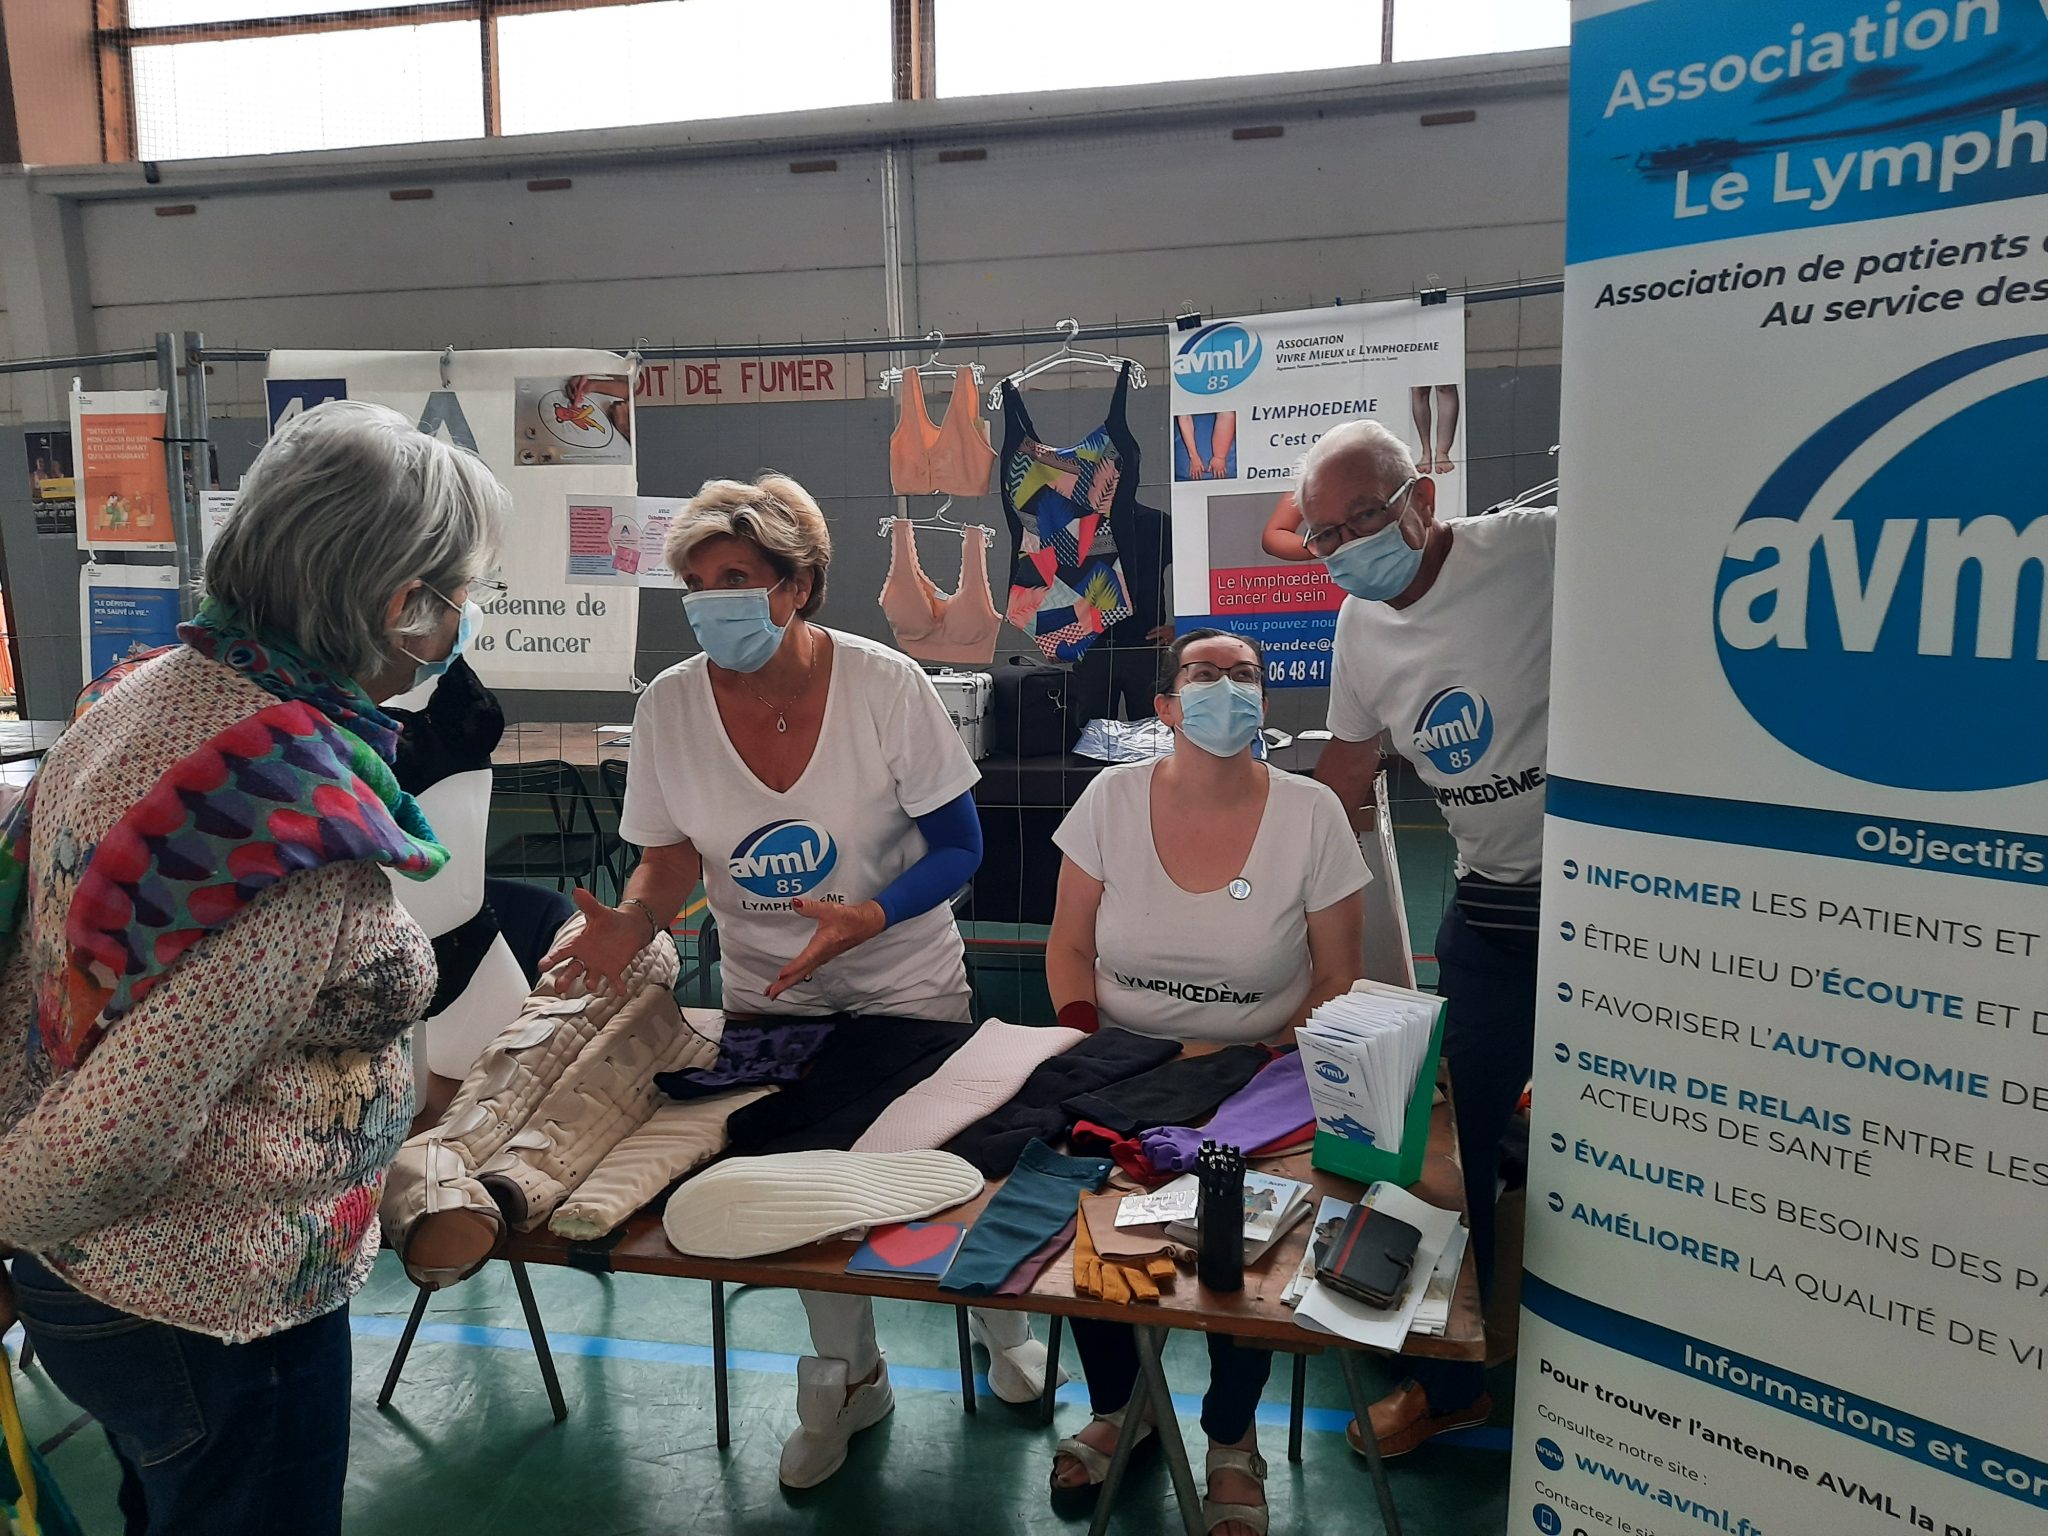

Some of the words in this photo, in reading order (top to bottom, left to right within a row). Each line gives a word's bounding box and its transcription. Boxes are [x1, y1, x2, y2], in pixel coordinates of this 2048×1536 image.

[1603, 0, 2000, 119] Association
[1673, 169, 1749, 219] Le
[1594, 261, 1785, 308] Association
[1797, 253, 1845, 283] de
[1854, 232, 2030, 284] patients
[1760, 301, 1812, 328] Au
[1823, 286, 1964, 323] service
[1976, 275, 2048, 307] des
[684, 364, 722, 395] DE
[741, 360, 835, 393] FUMER
[1174, 339, 1244, 375] avml
[1207, 375, 1229, 391] 85
[1252, 399, 1378, 421] LYMPHOEDEME
[1270, 432, 1306, 447] C'est
[576, 592, 606, 616] de
[1218, 575, 1236, 589] Le
[1218, 593, 1267, 605] cancer
[1272, 590, 1290, 603] du
[1296, 588, 1326, 602] sein
[505, 628, 591, 653] Cancer
[1230, 620, 1259, 631] Vous
[1262, 619, 1307, 633] pouvez
[1269, 661, 1285, 681] 06
[1289, 660, 1305, 680] 48
[1310, 660, 1325, 680] 41
[1412, 705, 1480, 753] avml
[1450, 749, 1472, 769] 85
[728, 840, 817, 878] avml
[1855, 825, 2046, 874] Objectifs
[777, 878, 802, 893] 85
[1586, 864, 1742, 909] INFORMER
[1751, 890, 1808, 919] LES
[1818, 900, 1983, 949] PATIENTS
[1995, 929, 2040, 957] ET
[1583, 923, 1650, 960] ÊTRE
[1659, 942, 1701, 970] UN
[1712, 951, 1779, 983] LIEU
[1791, 966, 1964, 1020] D'ÉCOUTE
[1976, 1000, 2021, 1029] ET
[1581, 989, 1740, 1043] FAVORISER
[1750, 1027, 1990, 1099] L'AUTONOMIE
[2002, 1079, 2048, 1112] DE
[1577, 1050, 1678, 1094] SERVIR
[1686, 1079, 1728, 1106] DE
[1738, 1090, 1852, 1137] RELAIS
[1862, 1121, 1974, 1168] ENTRE
[1987, 1150, 2048, 1187] LES
[1580, 1082, 1709, 1134] ACTEURS
[1718, 1117, 1759, 1147] DE
[1768, 1131, 1873, 1177] SANTÉ
[1574, 1141, 1705, 1197] ÉVALUER
[1713, 1181, 1768, 1215] LES
[1776, 1200, 1920, 1259] BESOINS
[1931, 1243, 2002, 1284] DES
[1571, 1203, 1740, 1272] AMÉLIORER
[1749, 1257, 1787, 1287] LA
[1794, 1272, 1937, 1336] QUALITÉ
[1948, 1319, 1998, 1356] DE
[1683, 1344, 1917, 1449] Informations
[1927, 1438, 1969, 1470] et
[1537, 1404, 1614, 1448] Consultez
[1618, 1440, 1665, 1467] notre
[1668, 1461, 1699, 1482] site
[1540, 1357, 1589, 1394] Pour
[1594, 1384, 1682, 1430] trouver
[1689, 1418, 1809, 1481] l'antenne
[1816, 1471, 1901, 1519] AVML
[1909, 1504, 1935, 1533] la
[1534, 1480, 1614, 1526] Contactez
[1617, 1516, 1632, 1533] le
[1575, 1452, 1762, 1536] www.avml.fr
